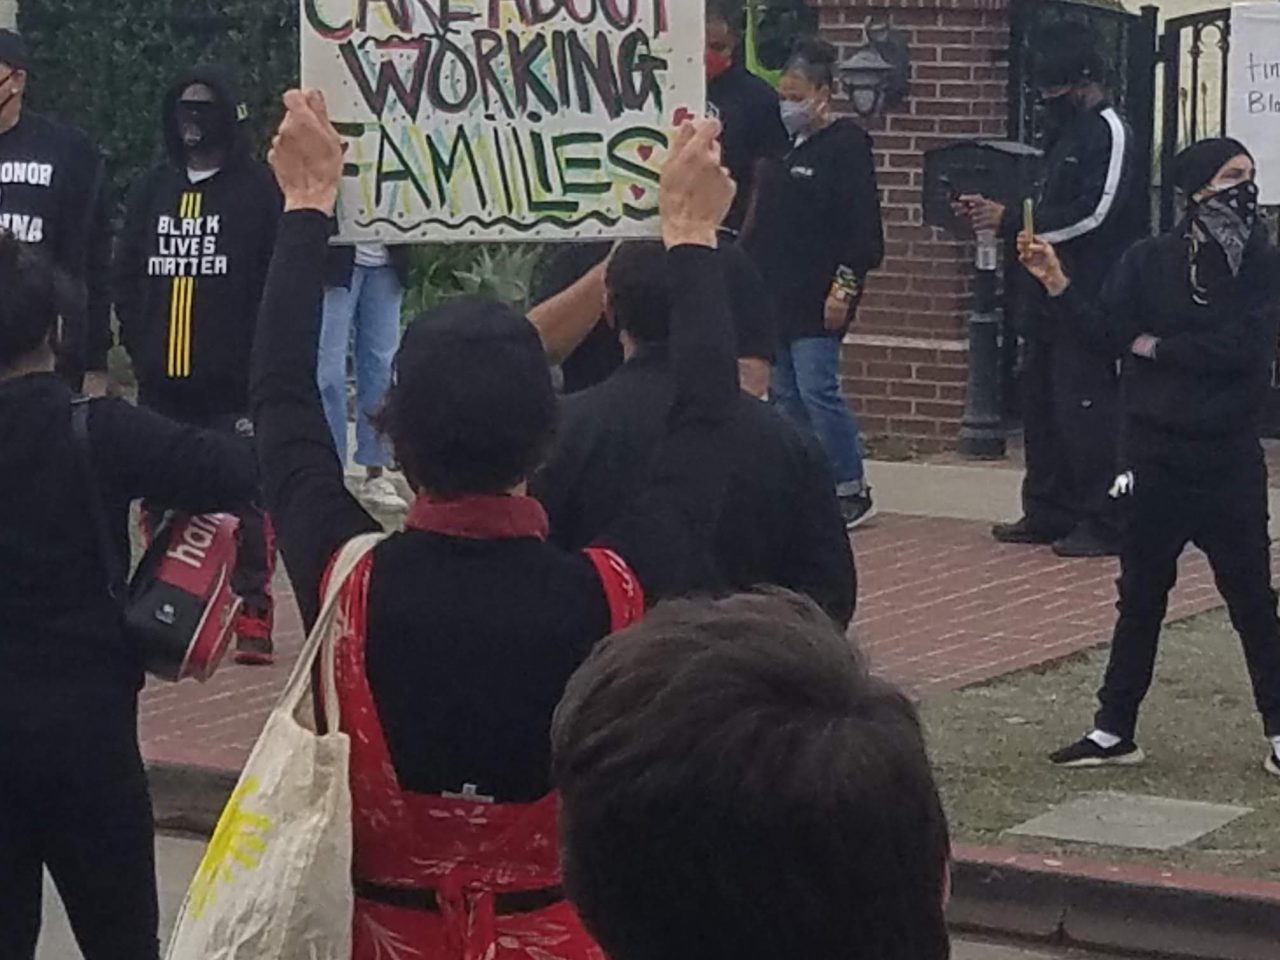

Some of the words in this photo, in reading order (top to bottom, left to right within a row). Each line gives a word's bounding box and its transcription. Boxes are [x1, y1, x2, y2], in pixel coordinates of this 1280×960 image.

[338, 27, 668, 123] WORKING
[157, 214, 220, 236] BLACK
[158, 235, 217, 257] LIVES
[147, 255, 228, 276] MATTER
